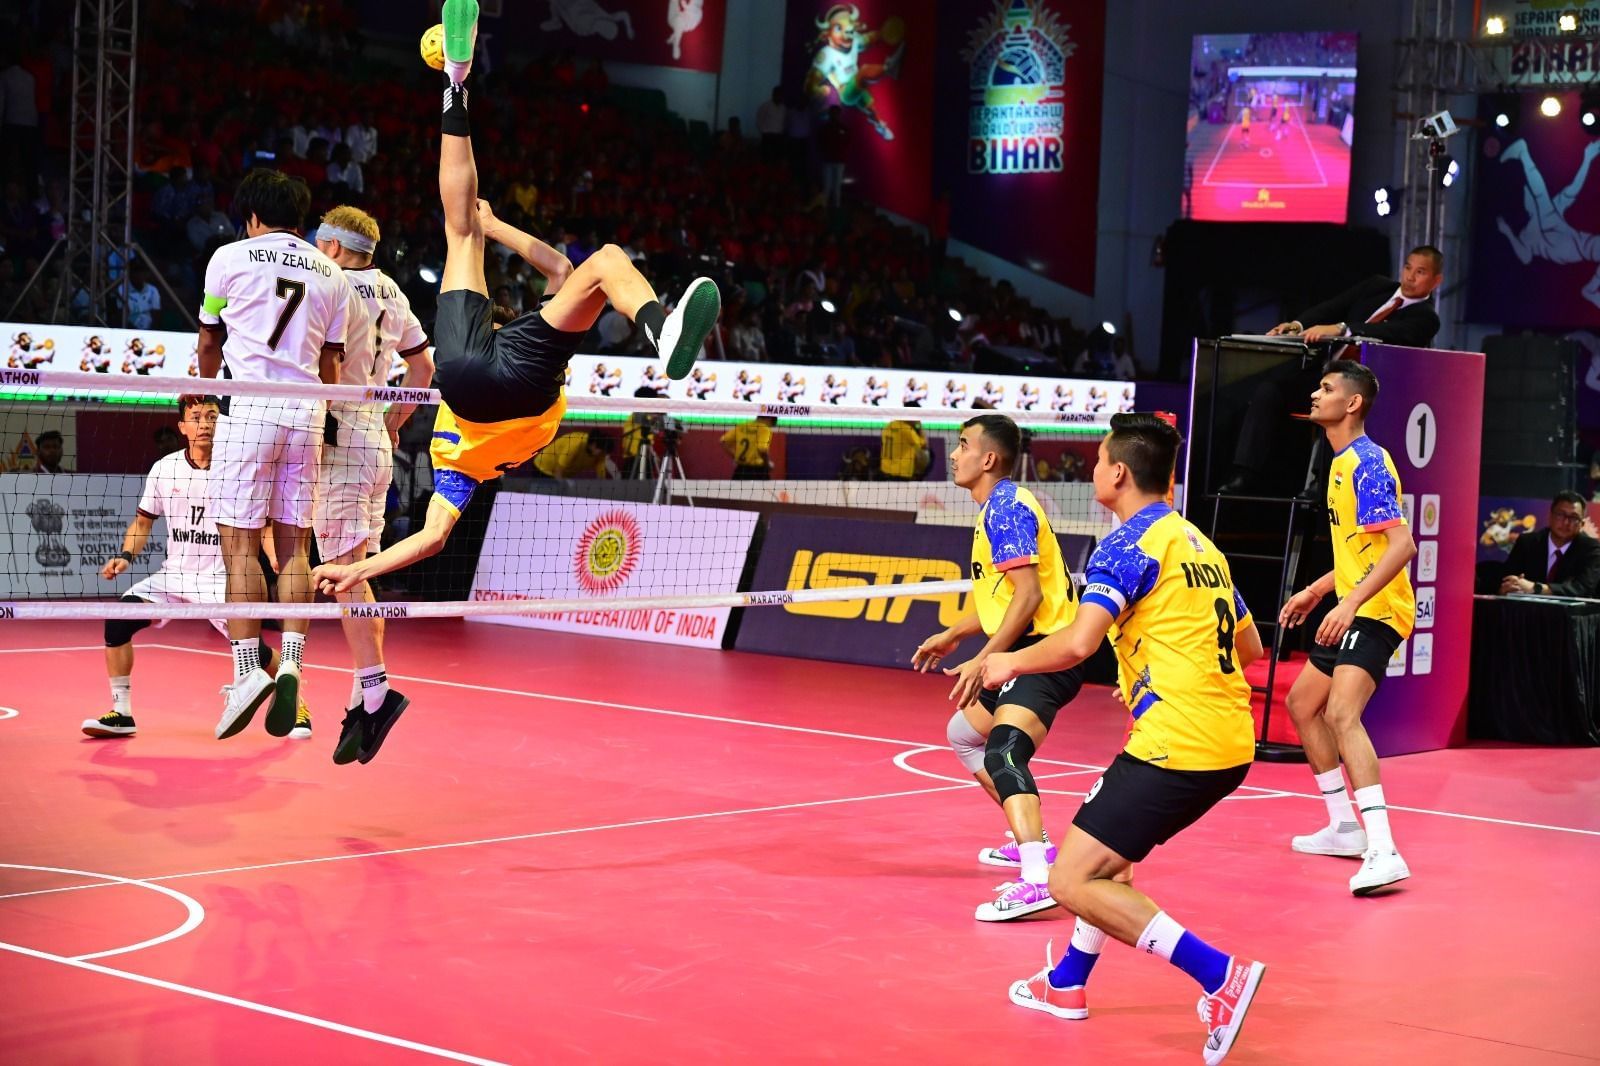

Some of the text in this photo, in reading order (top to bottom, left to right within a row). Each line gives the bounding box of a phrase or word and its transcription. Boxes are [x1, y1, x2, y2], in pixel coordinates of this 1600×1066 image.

[968, 137, 1063, 173] BIHAR
[249, 249, 332, 278] NEW ZEALAND
[267, 276, 306, 351] 7
[374, 390, 431, 402] MARATHON
[766, 405, 810, 416] MARATHON
[1060, 413, 1095, 423] MARATHON
[1416, 412, 1427, 459] 1
[190, 505, 206, 526] 17
[172, 528, 222, 546] KiwTakra
[78, 543, 116, 554] YOUTH
[81, 555, 106, 567] AND
[783, 549, 975, 628] ISTA
[750, 593, 793, 605] MARATHON
[350, 606, 407, 618] MARATHON
[654, 610, 674, 634] OF
[676, 611, 717, 640] INDIA
[1213, 597, 1236, 675] 9
